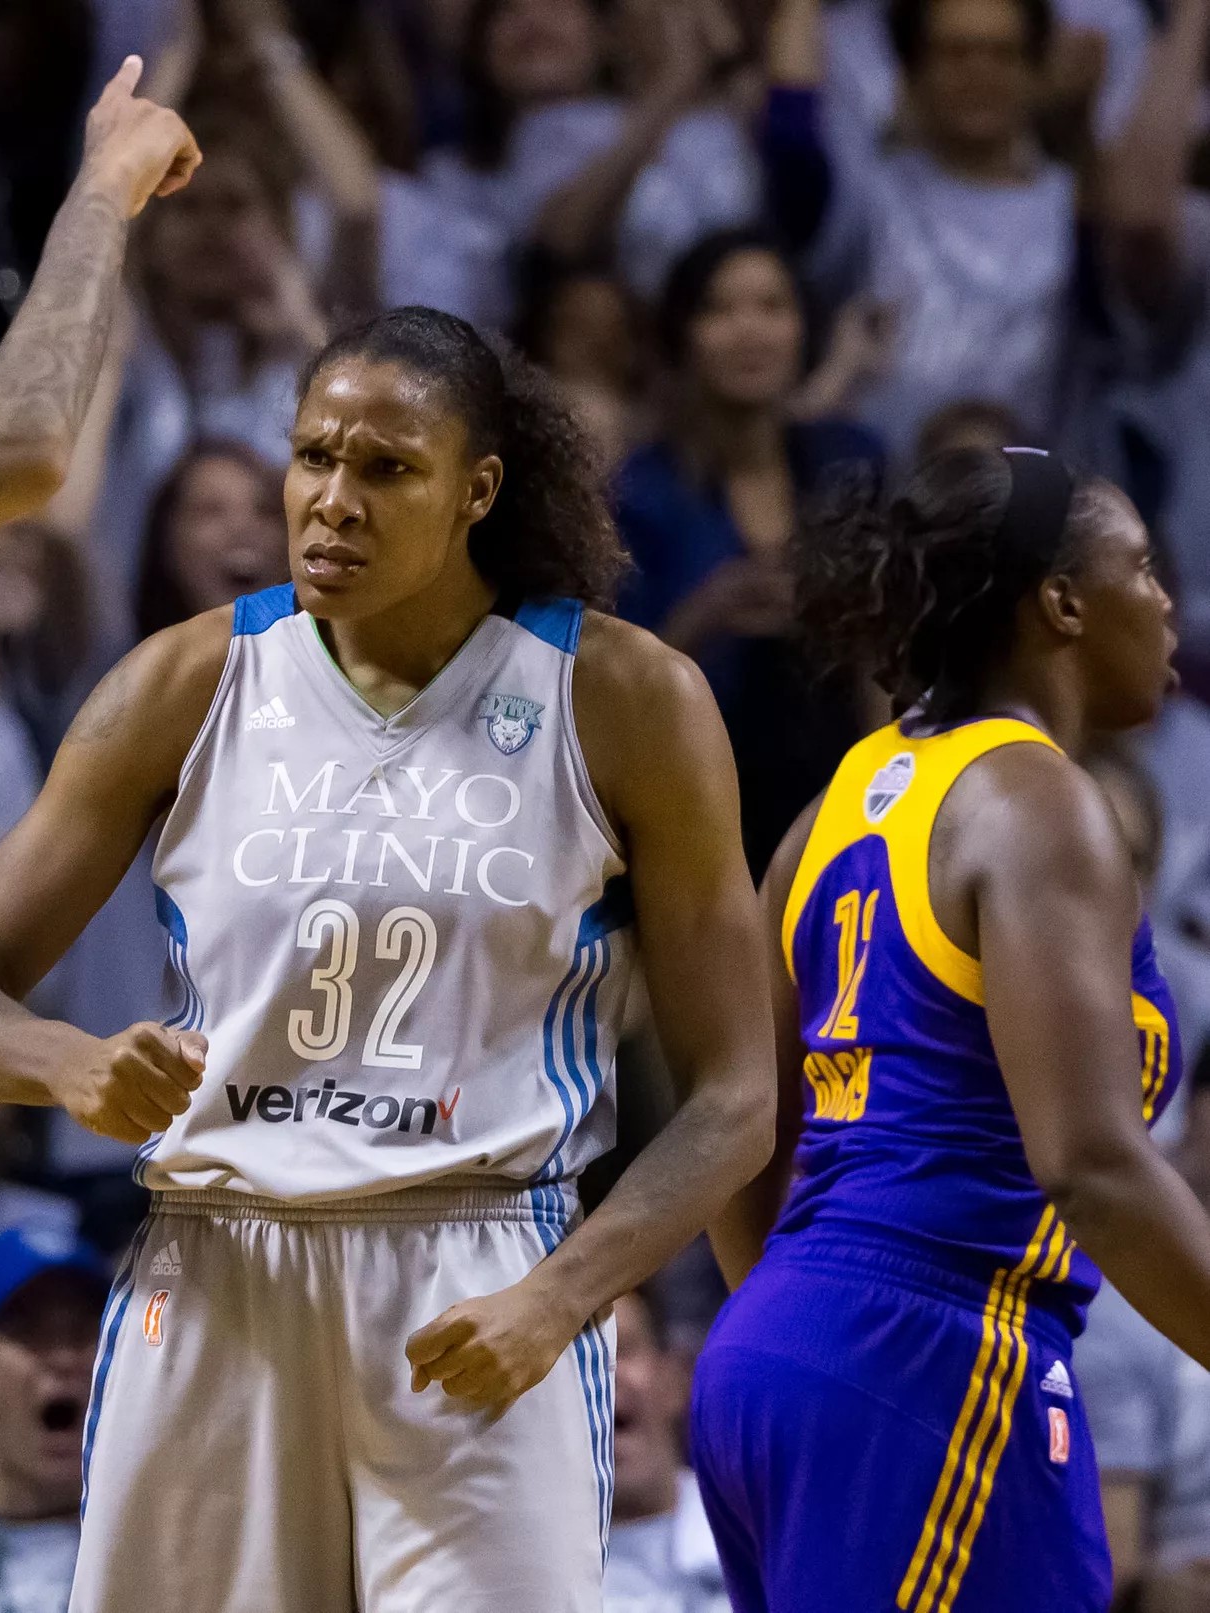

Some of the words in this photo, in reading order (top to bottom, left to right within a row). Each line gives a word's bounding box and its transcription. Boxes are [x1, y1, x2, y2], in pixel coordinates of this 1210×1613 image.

[244, 716, 296, 731] adidas
[260, 760, 522, 828] MAYO
[233, 827, 535, 907] CLINIC
[287, 898, 438, 1070] 32
[225, 1078, 438, 1135] verizon
